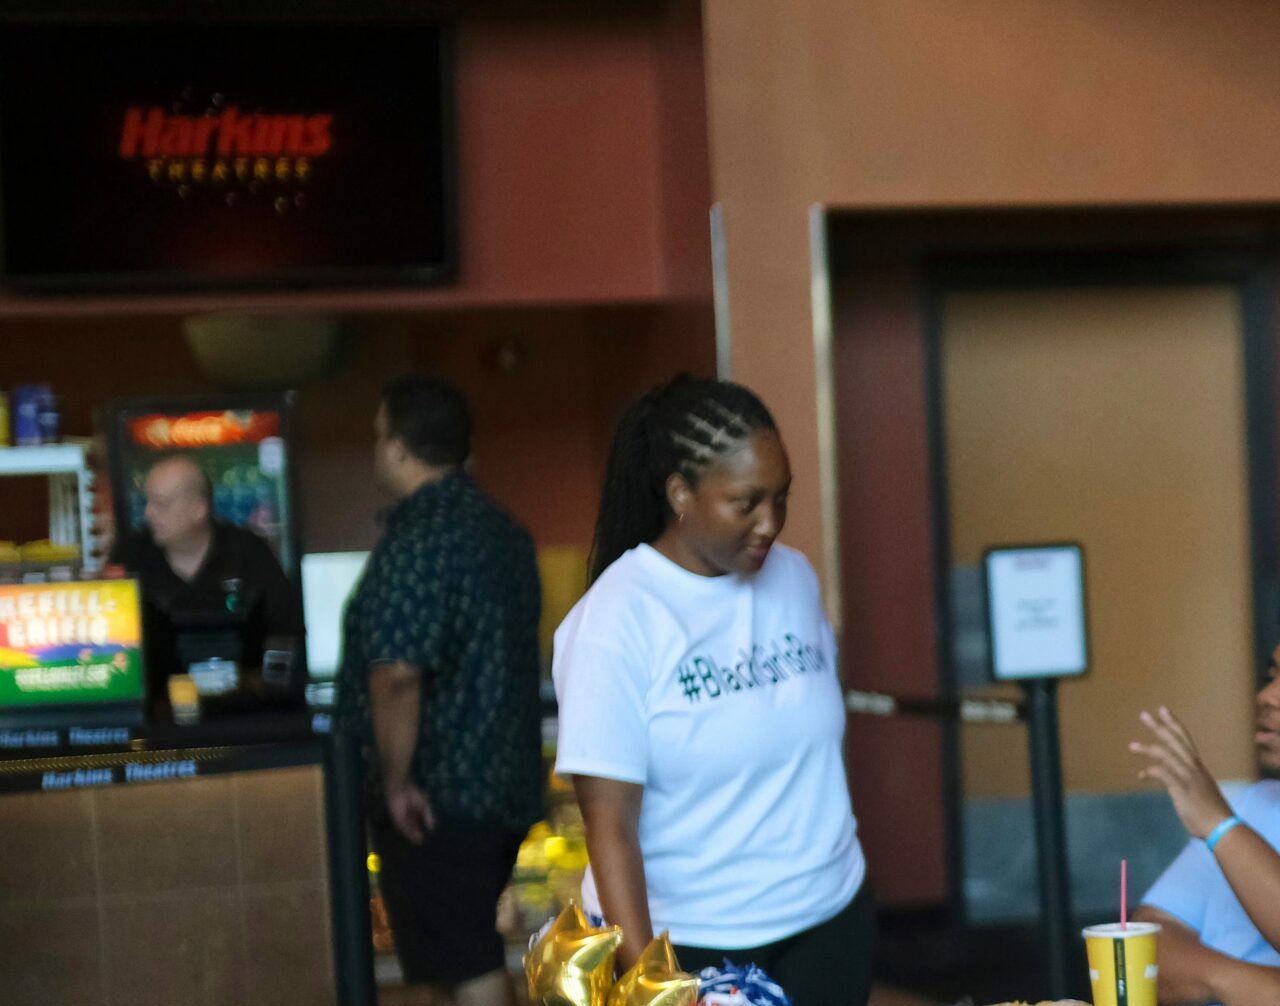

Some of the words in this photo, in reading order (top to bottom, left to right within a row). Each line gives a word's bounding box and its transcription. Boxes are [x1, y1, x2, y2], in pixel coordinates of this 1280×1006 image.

[120, 107, 333, 157] Harkins
[148, 157, 311, 180] THEATRES
[42, 768, 113, 790] Harkins
[125, 760, 197, 782] Theatres
